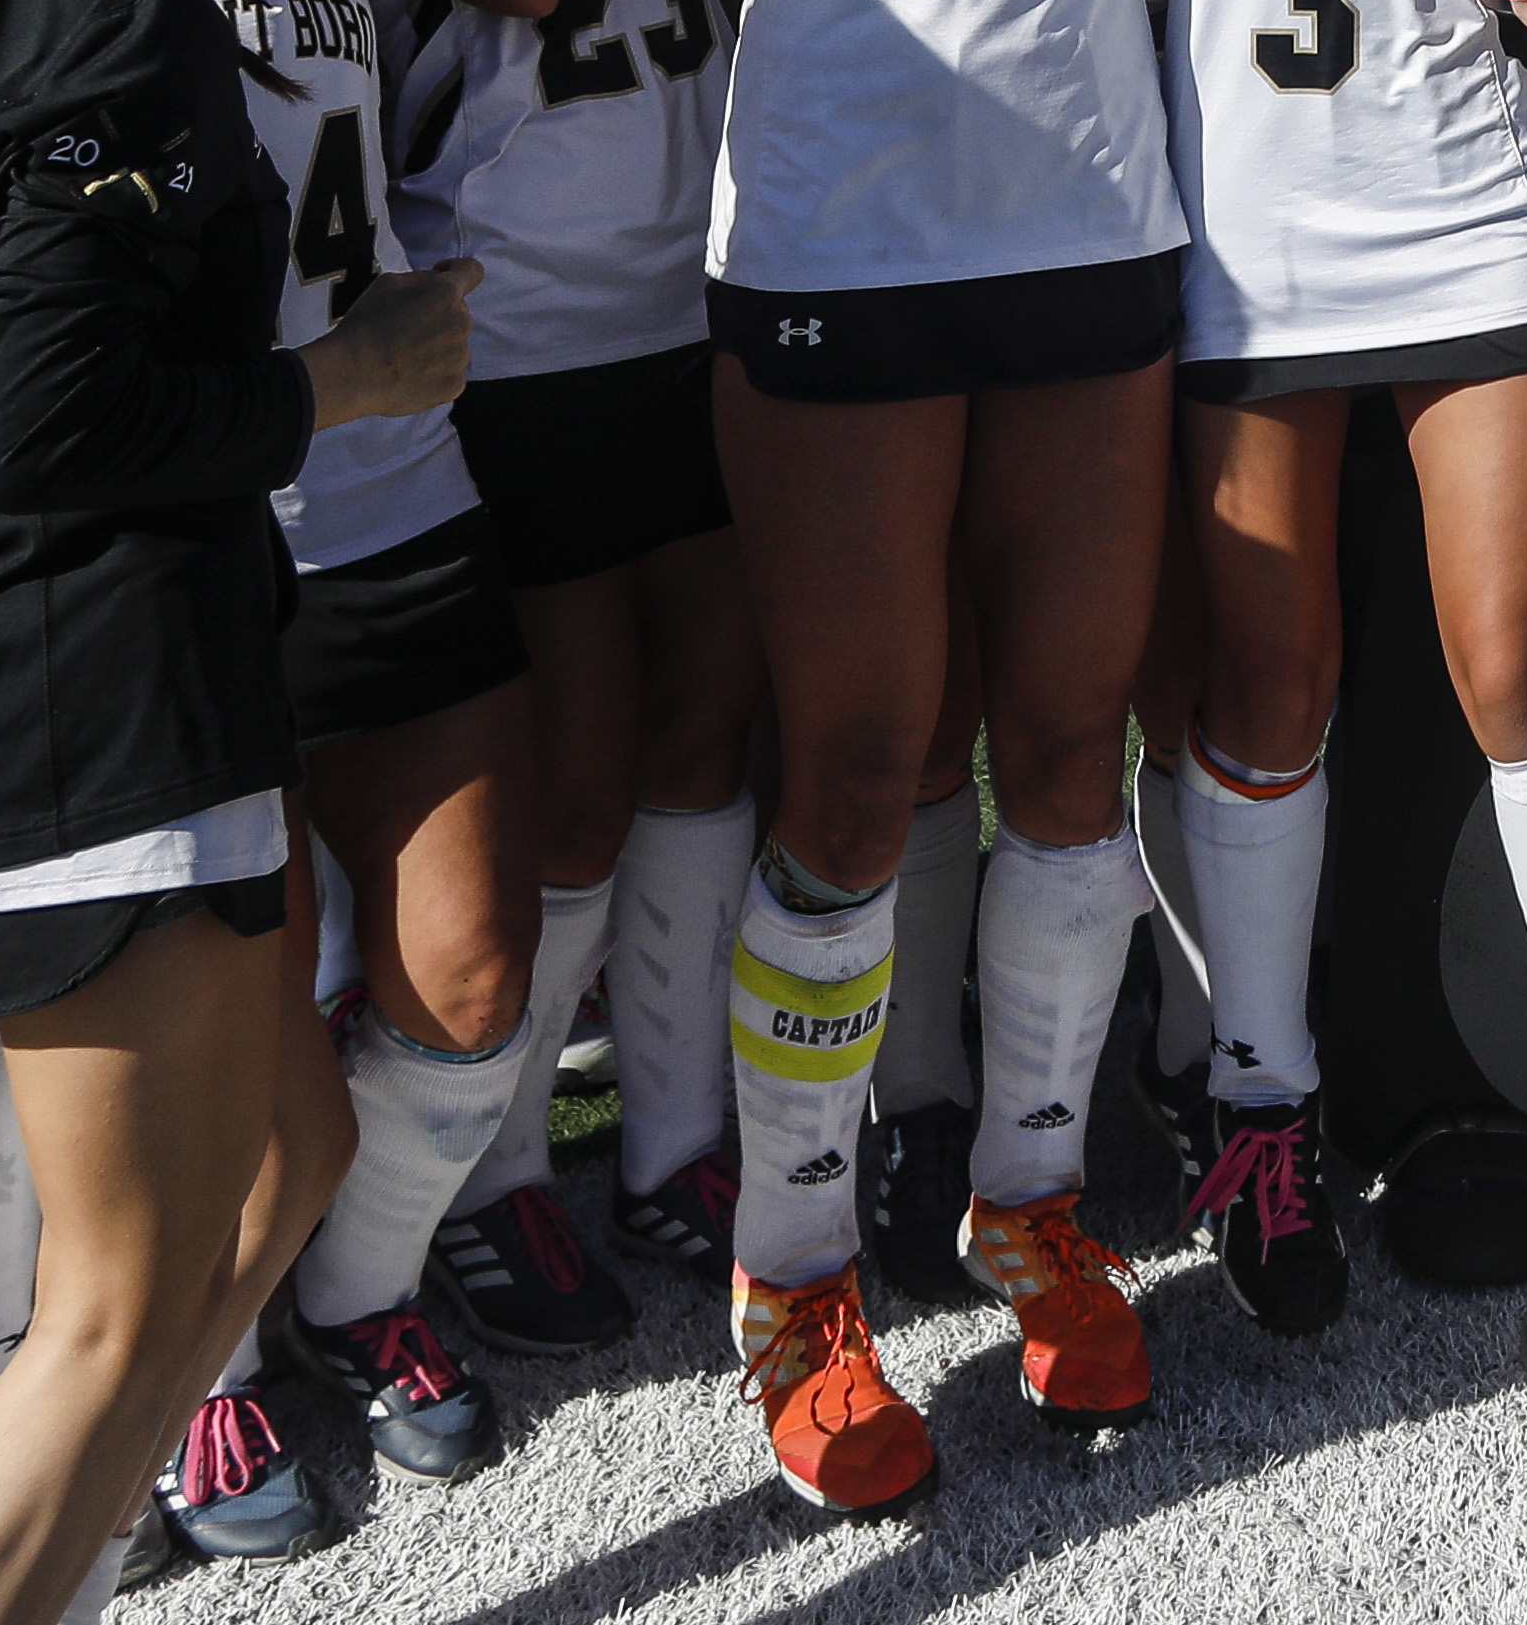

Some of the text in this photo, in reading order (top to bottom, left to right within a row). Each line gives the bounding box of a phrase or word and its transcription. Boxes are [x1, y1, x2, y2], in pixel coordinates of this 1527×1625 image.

[47, 134, 194, 193] 20 21
[1018, 1112, 1076, 1131] adidas
[787, 1160, 850, 1186] adidas
